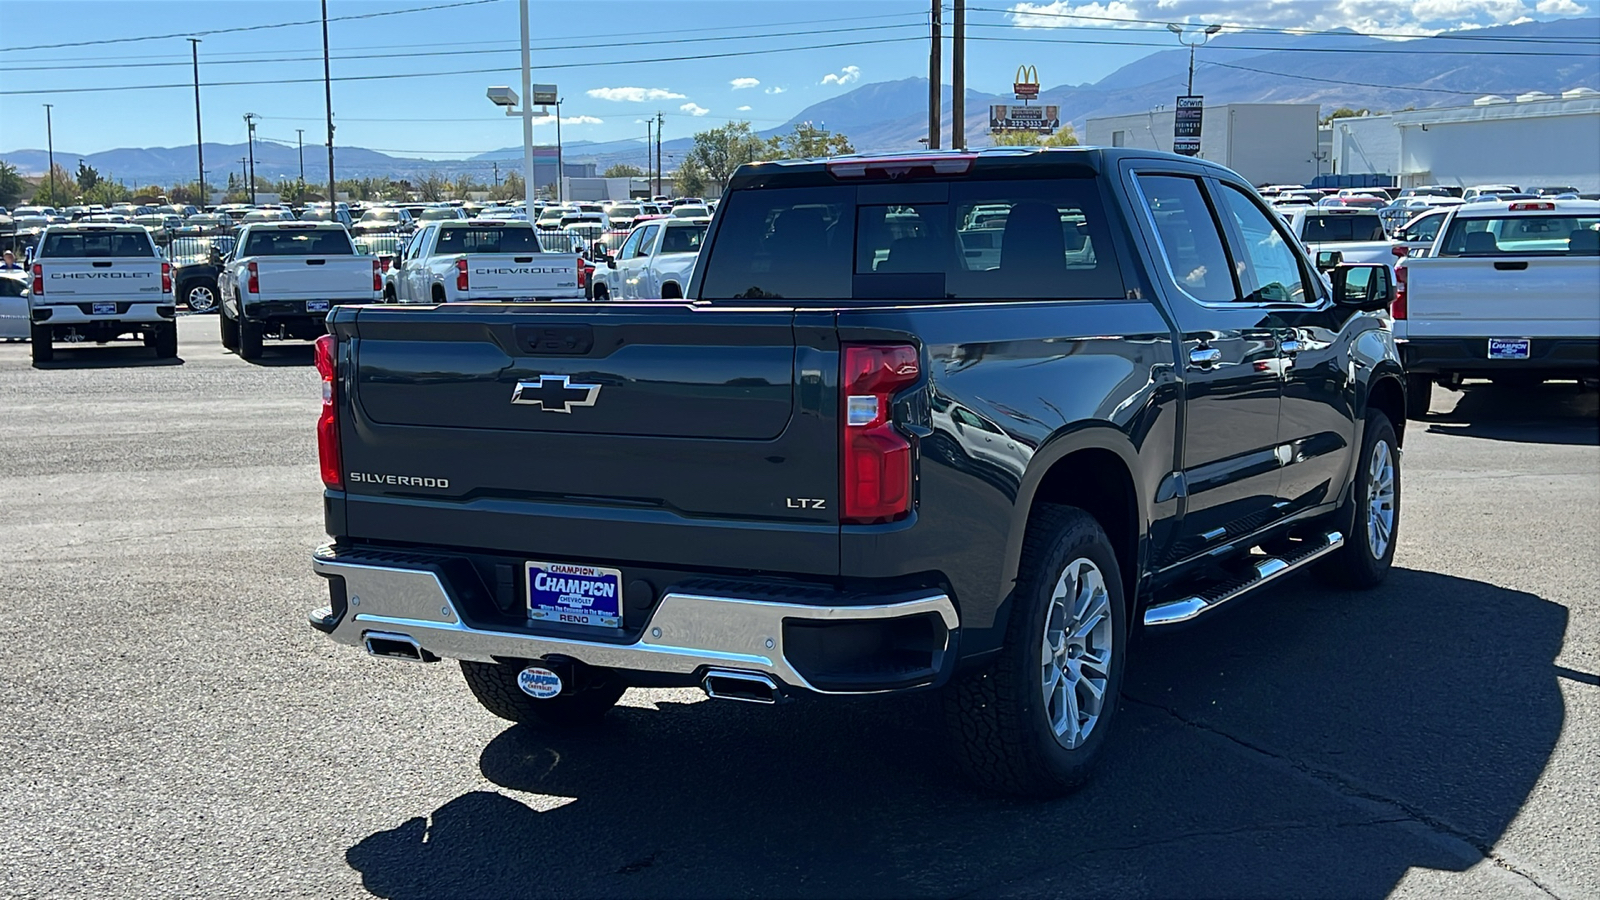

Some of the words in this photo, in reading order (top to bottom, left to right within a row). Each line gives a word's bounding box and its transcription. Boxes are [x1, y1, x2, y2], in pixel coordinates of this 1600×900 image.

[1178, 99, 1203, 107] Corwin
[1177, 110, 1201, 118] GMC
[476, 267, 570, 275] CHEVROLET
[1492, 342, 1527, 350] CHAMPION
[350, 472, 449, 488] SILVERADO
[786, 498, 826, 509] LTZ
[551, 565, 595, 576] CHAMPION
[534, 572, 615, 598] CHAMPION
[560, 596, 591, 605] CHEVROLET
[559, 614, 589, 624] RENO
